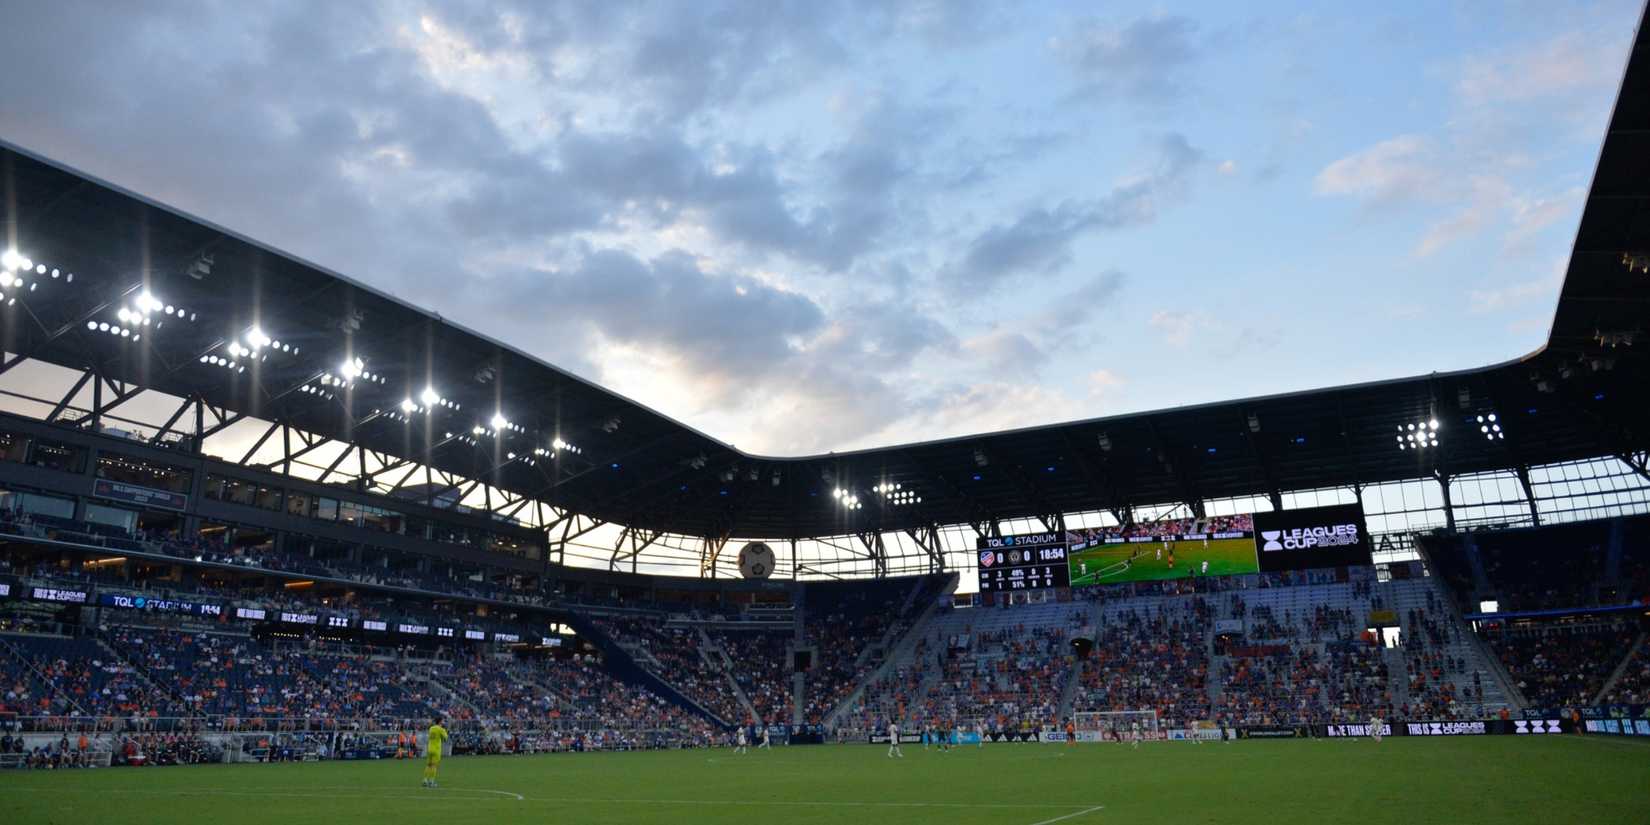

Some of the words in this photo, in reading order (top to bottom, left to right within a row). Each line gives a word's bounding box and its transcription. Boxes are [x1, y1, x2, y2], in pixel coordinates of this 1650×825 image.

[1282, 523, 1358, 540] LEAGUES
[987, 538, 1005, 547] TQL
[1015, 534, 1057, 545] STADIUM
[997, 553, 1004, 563] 0
[1023, 551, 1031, 561] 0
[1039, 548, 1065, 560] 18:54
[113, 596, 134, 607] TQL
[1347, 724, 1365, 736] THAN
[1408, 723, 1422, 735] THIS
[1423, 723, 1430, 735] IS
[1442, 722, 1485, 730] LEAGUES
